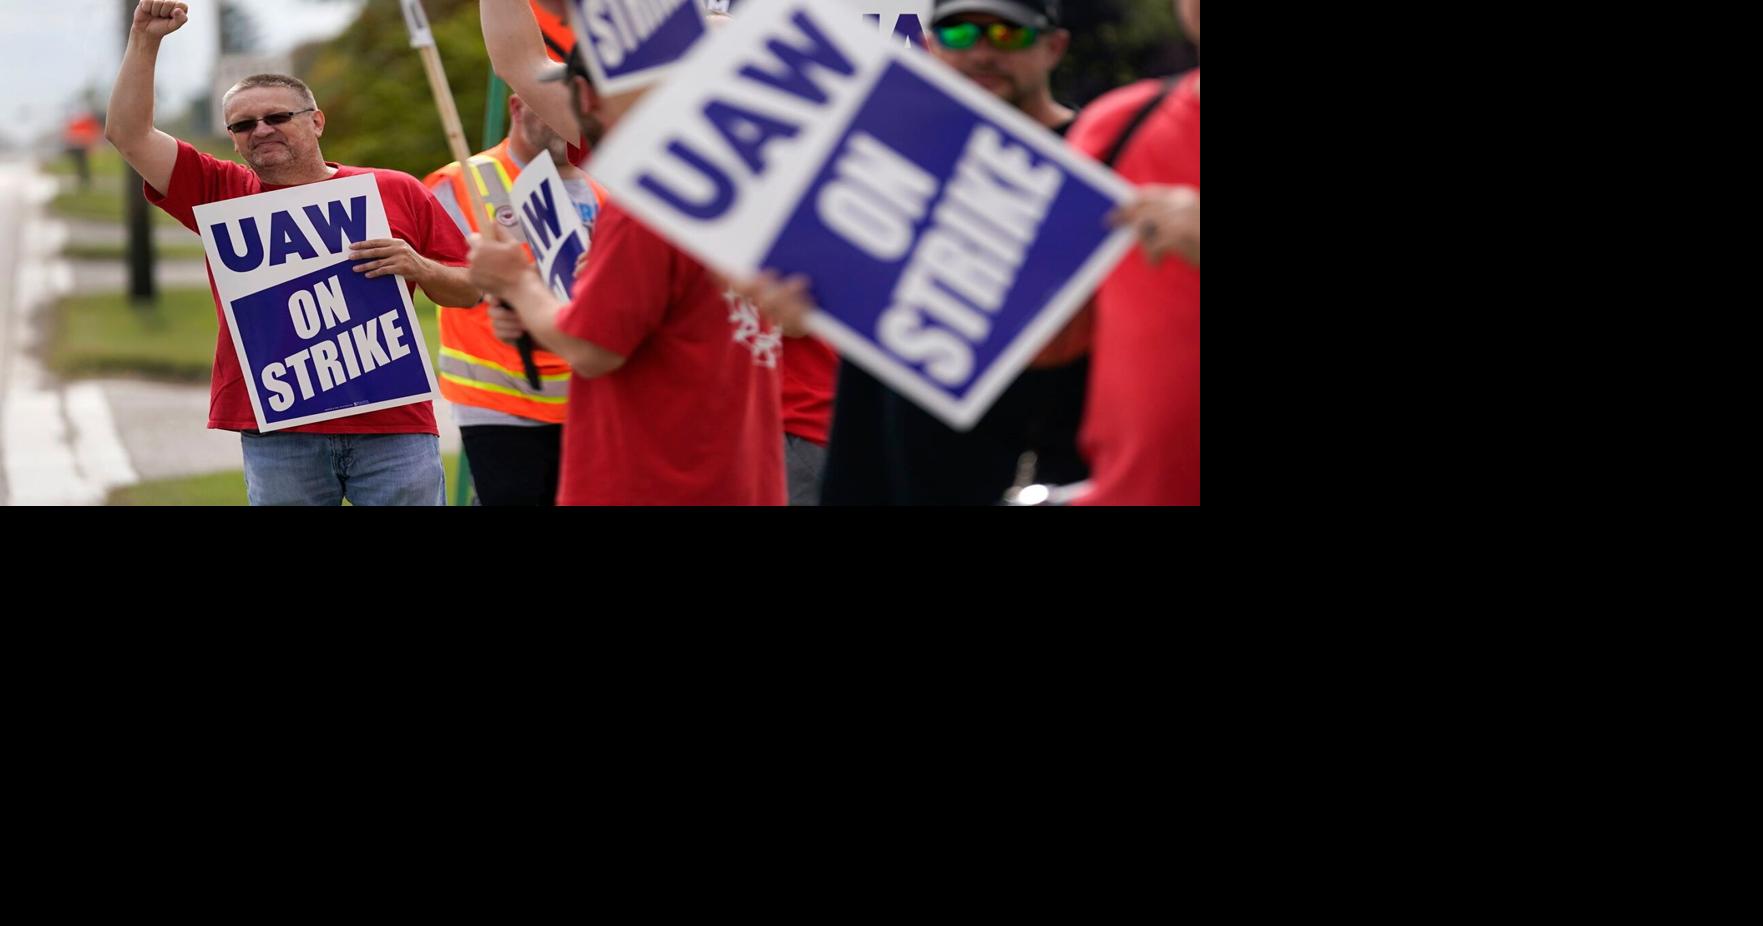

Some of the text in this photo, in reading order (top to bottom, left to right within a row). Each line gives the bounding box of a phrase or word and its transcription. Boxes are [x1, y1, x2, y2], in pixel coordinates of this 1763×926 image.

[637, 10, 857, 222] UAW
[210, 195, 367, 272] UAW
[816, 133, 936, 259] ON
[288, 275, 351, 340] ON
[877, 123, 1064, 386] STRIKE
[261, 309, 411, 412] STRIKE
